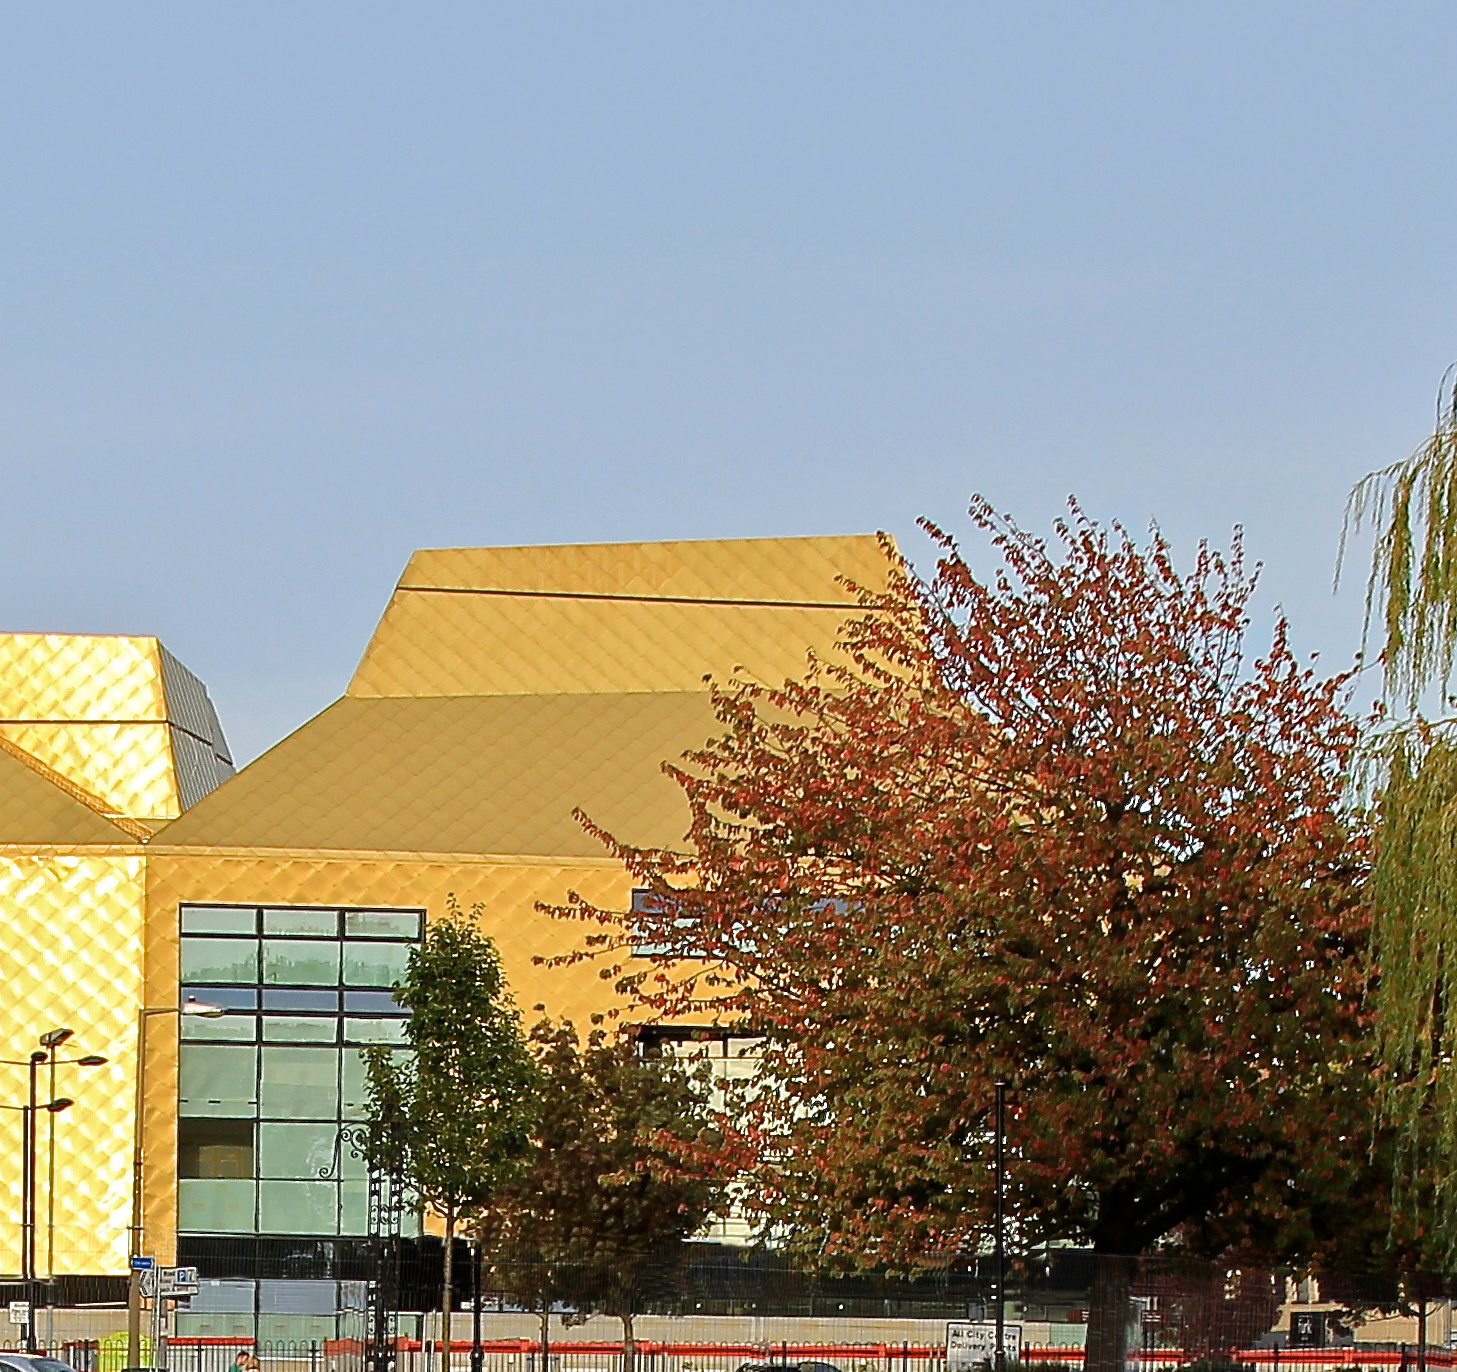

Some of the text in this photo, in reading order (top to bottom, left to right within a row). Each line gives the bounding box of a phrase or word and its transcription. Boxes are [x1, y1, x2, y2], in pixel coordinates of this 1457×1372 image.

[952, 1329, 1017, 1340] All City Ctre
[950, 1341, 987, 1351] Delivery
